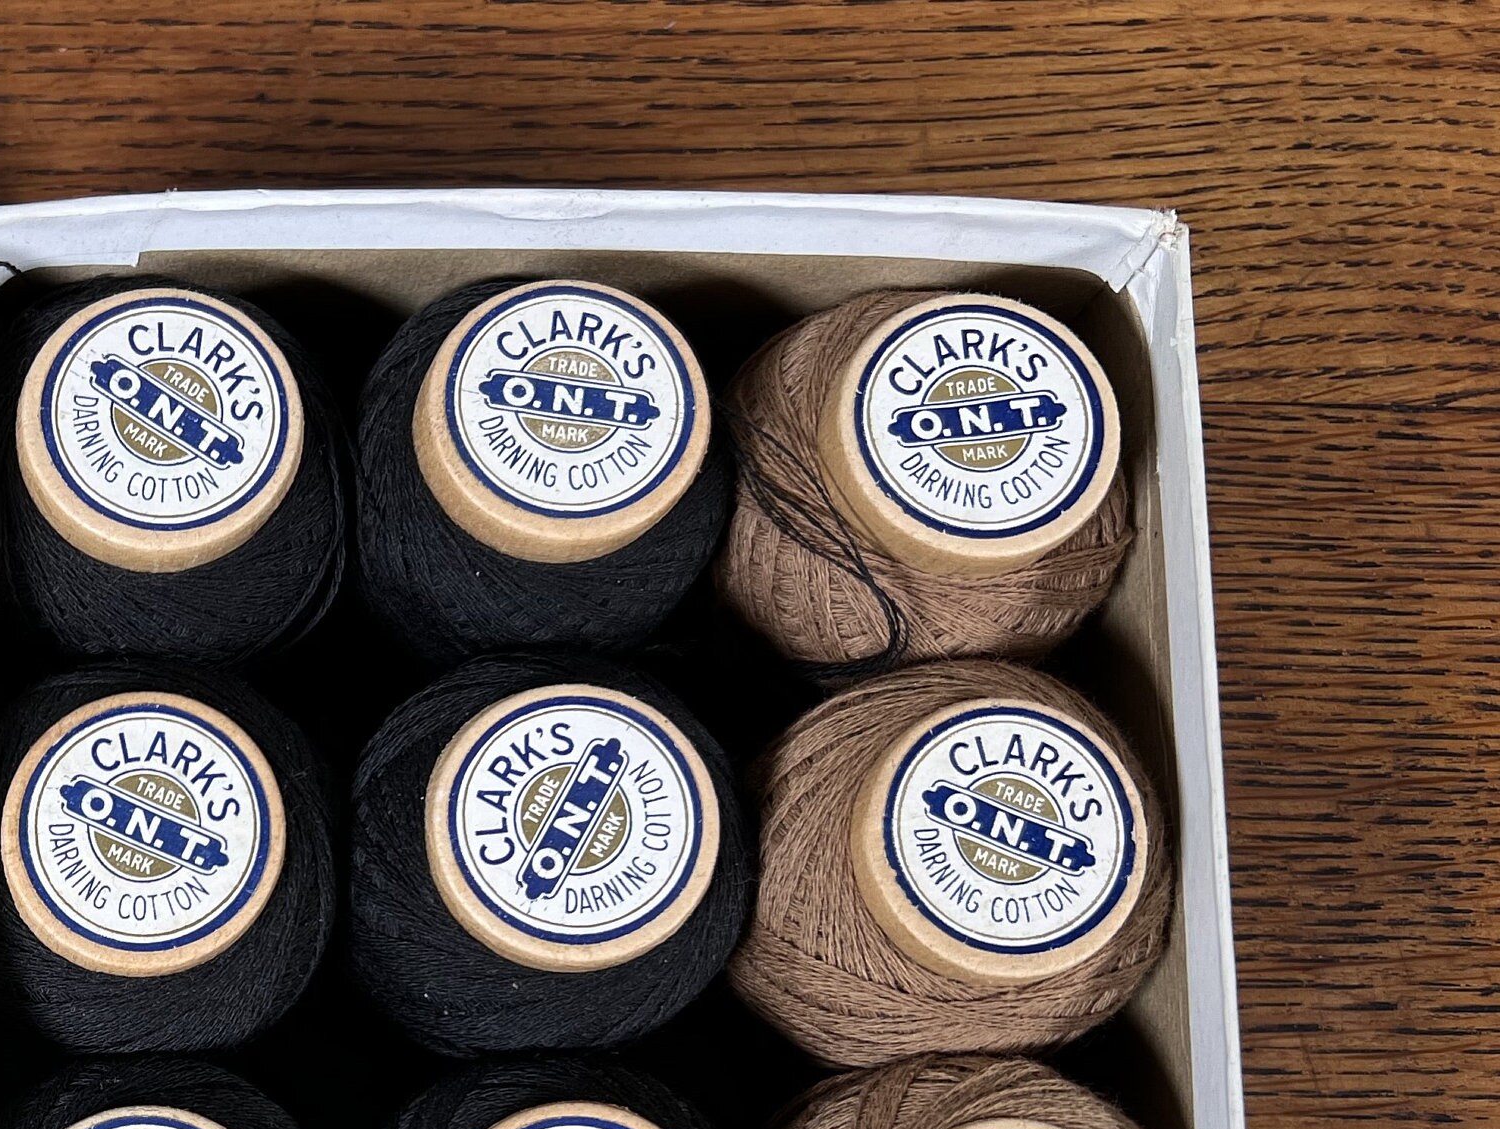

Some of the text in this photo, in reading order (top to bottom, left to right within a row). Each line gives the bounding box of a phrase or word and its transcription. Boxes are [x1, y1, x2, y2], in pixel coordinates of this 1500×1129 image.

[127, 321, 265, 422] CLARK'S
[496, 309, 657, 379] CLARK'S
[548, 356, 600, 380] TRADE
[887, 328, 1049, 396] CLARK'S
[163, 365, 211, 405] TRADE
[944, 376, 998, 397] TRADE
[71, 393, 221, 503] DARNING COTTON
[122, 422, 169, 459] MARK
[477, 414, 653, 491] DARNING COTTON
[539, 423, 589, 445] MARK
[959, 444, 1008, 465] MARK
[898, 434, 1071, 510] DARNING COTTON
[91, 729, 242, 822] CLARK'S
[134, 777, 185, 813] TRADE
[474, 721, 575, 866] CLARK'S
[522, 776, 562, 826] TRADE
[948, 732, 1104, 823] CLARK'S
[995, 780, 1047, 814] TRADE
[103, 843, 153, 876] MARK
[564, 758, 672, 914] DARNING COTTON
[589, 813, 625, 861] MARK
[971, 847, 1021, 879] MARK
[48, 822, 211, 922] DARNING COTTON
[913, 827, 1082, 925] DARNING COTTON
